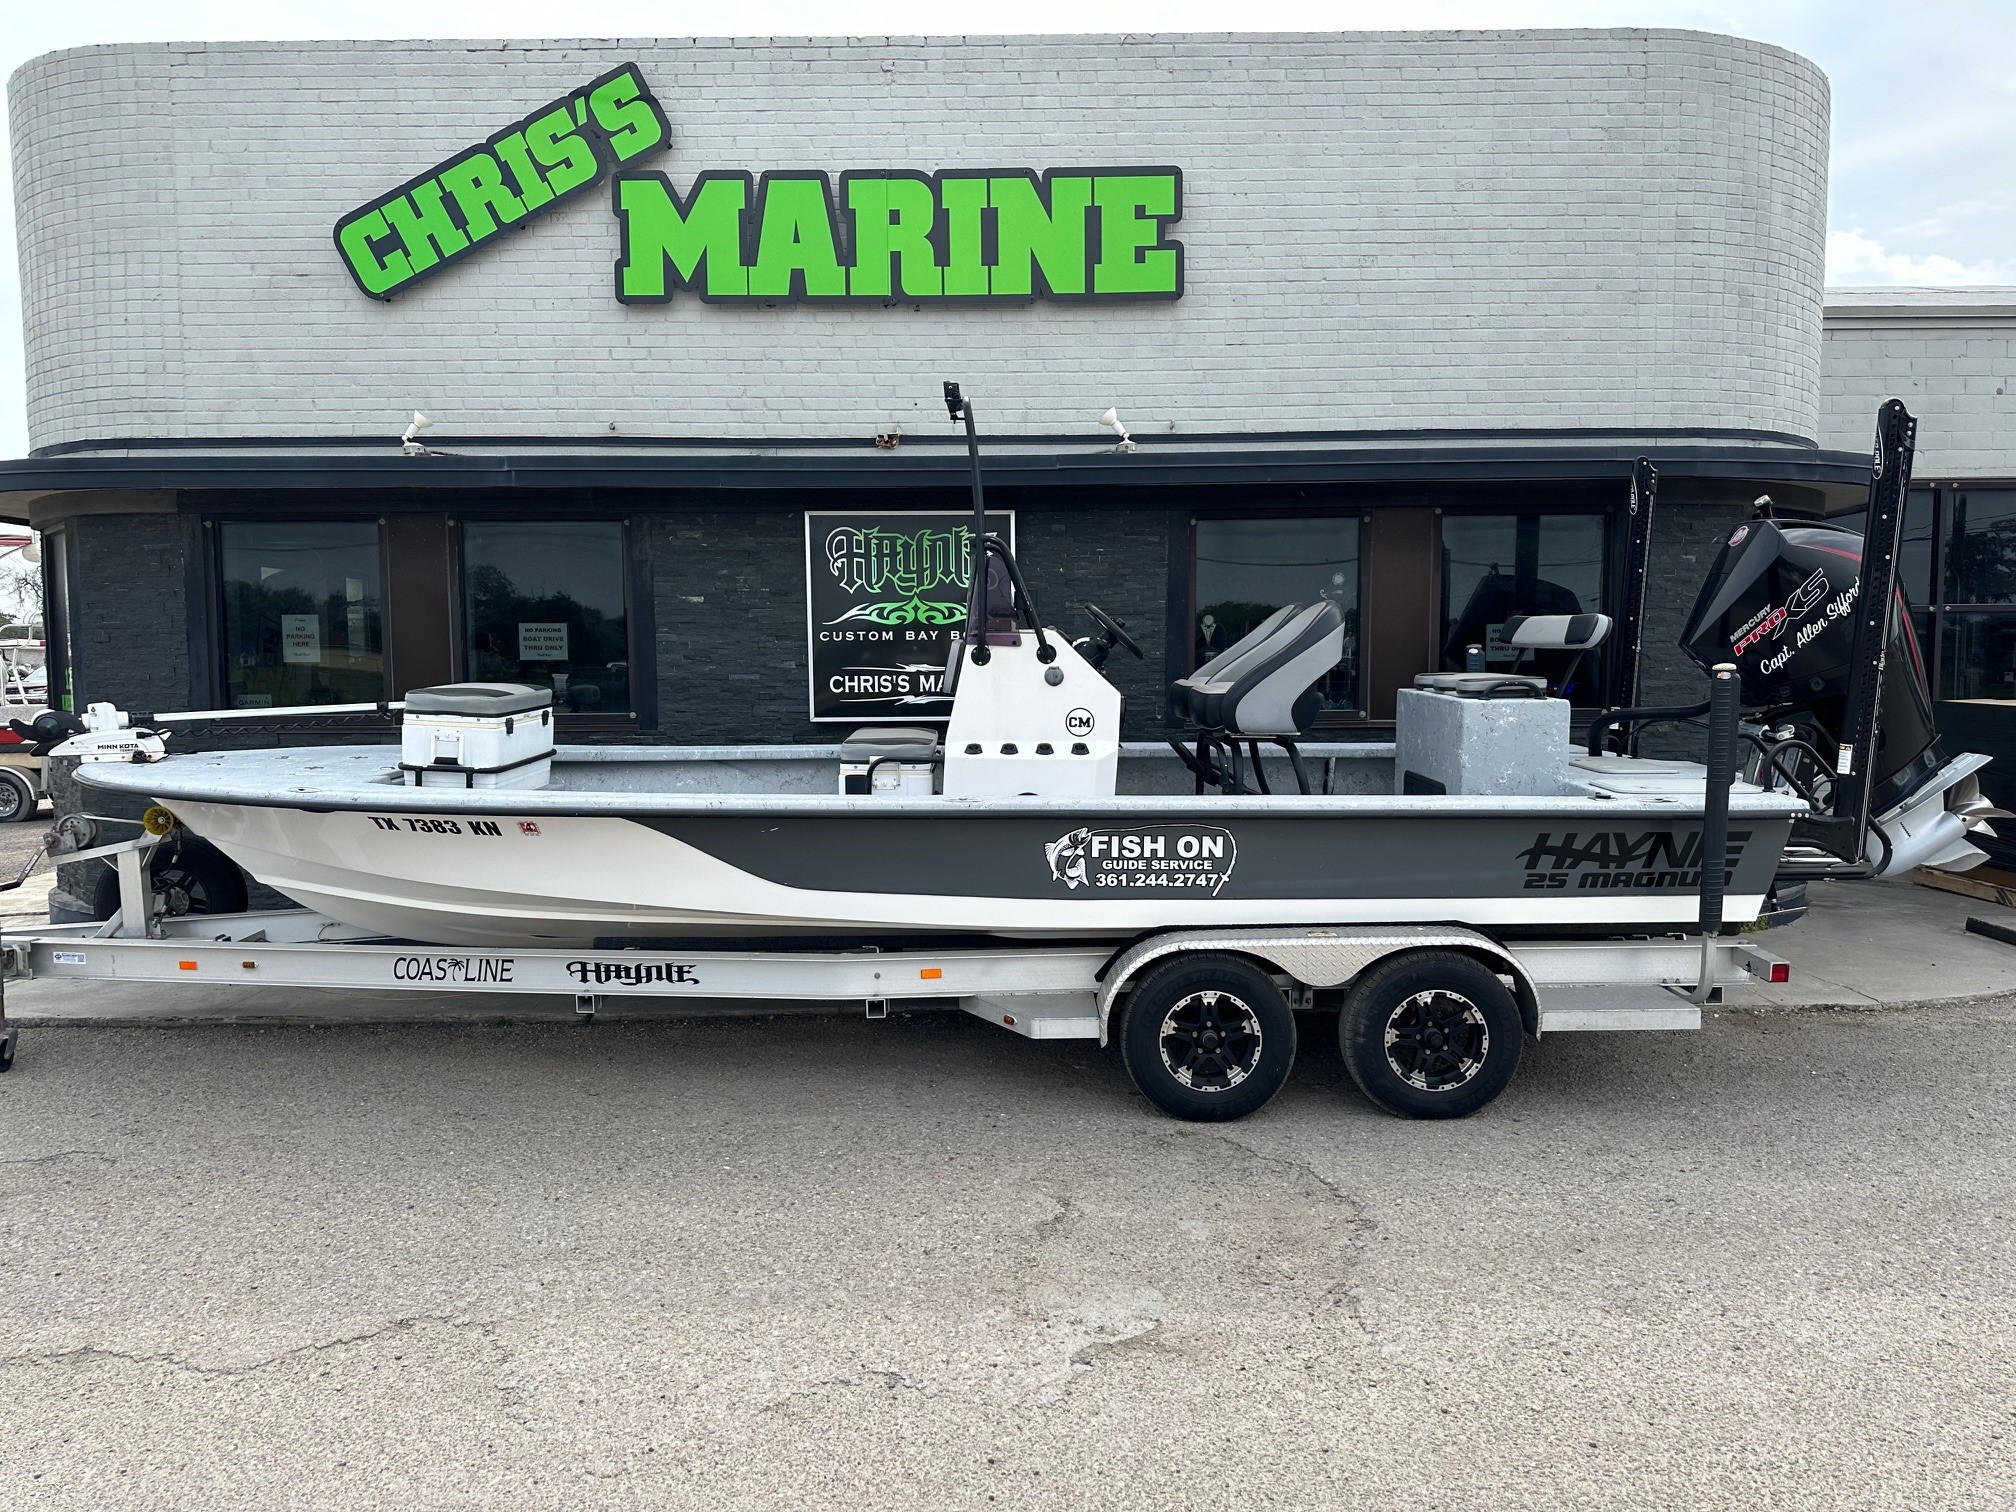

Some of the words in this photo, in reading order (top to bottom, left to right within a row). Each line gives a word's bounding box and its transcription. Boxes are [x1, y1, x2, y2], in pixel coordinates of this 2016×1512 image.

[340, 73, 661, 294] CHRIS'S
[621, 176, 1177, 295] MARINE
[1729, 603, 1772, 643] MERCURY
[819, 630, 894, 642] CUSTOM
[905, 630, 939, 641] BAY
[1760, 645, 1795, 675] Capt.
[1796, 618, 1829, 648] Allen
[829, 674, 910, 693] CHRIS'S
[1068, 716, 1092, 728] CM
[367, 816, 402, 831] TX
[401, 818, 463, 835] 7383
[466, 820, 503, 837] KN
[1091, 835, 1166, 858] FISH
[1176, 835, 1224, 858] ON
[1102, 860, 1148, 870] GUIDE
[1150, 860, 1213, 870] SERVICE
[1095, 873, 1220, 887] 361.244.2747
[1523, 873, 1569, 889] 25
